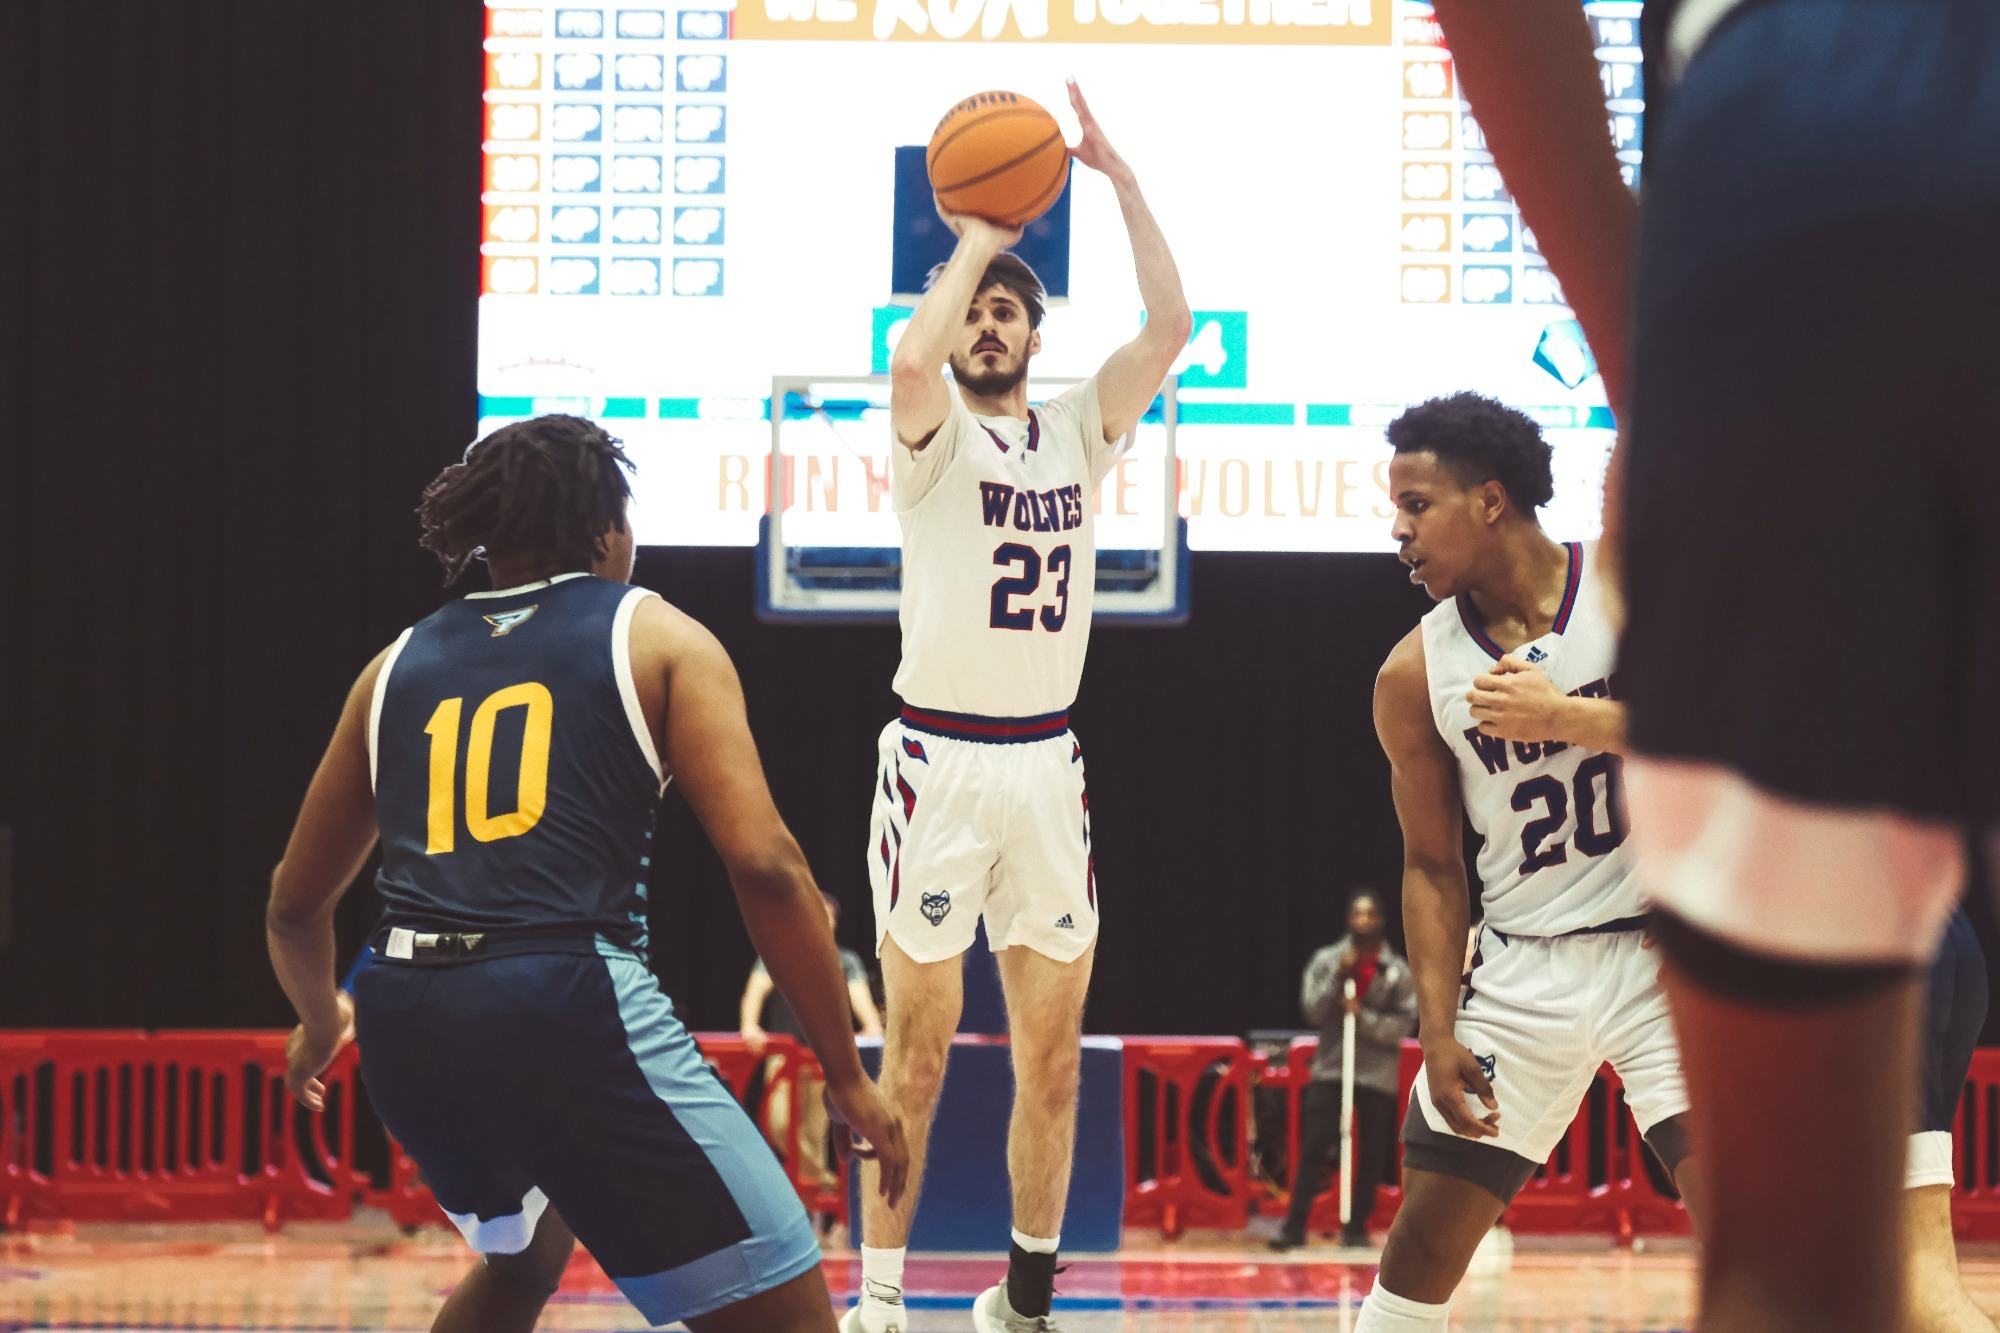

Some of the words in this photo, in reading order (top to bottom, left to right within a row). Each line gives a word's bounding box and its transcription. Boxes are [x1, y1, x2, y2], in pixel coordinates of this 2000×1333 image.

[980, 480, 1082, 533] WOLVES
[990, 542, 1071, 632] 23
[424, 682, 552, 855] 10
[1511, 752, 1631, 875] 20
